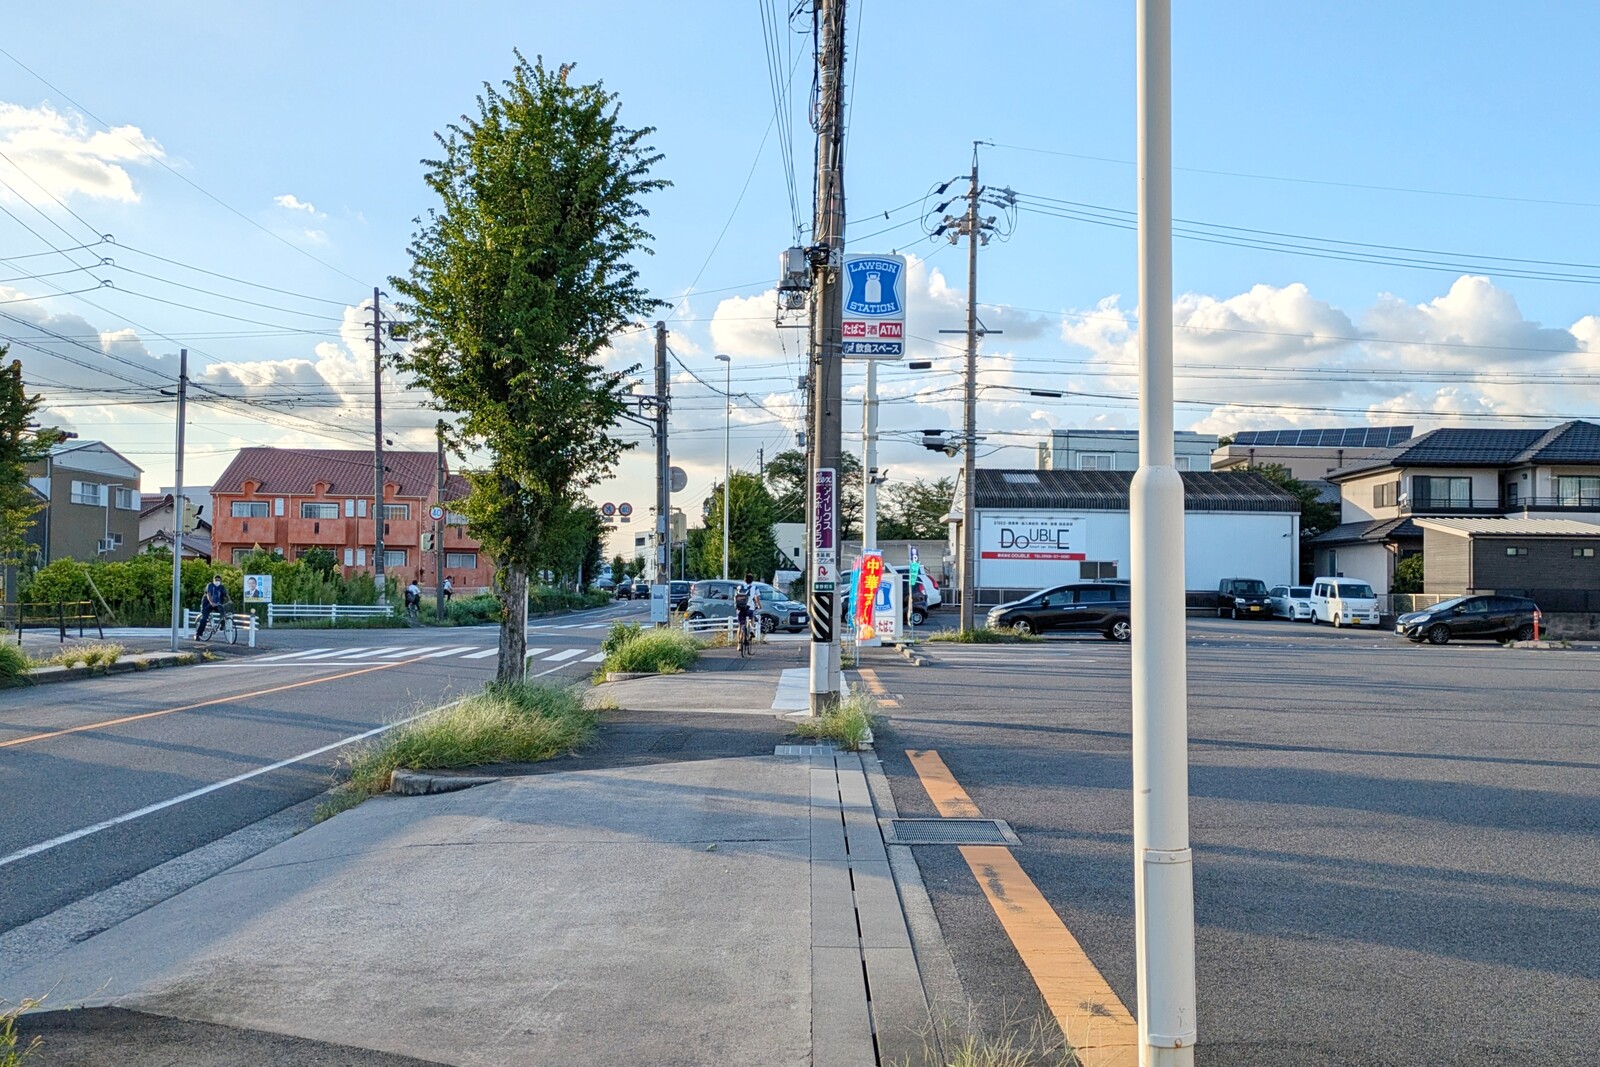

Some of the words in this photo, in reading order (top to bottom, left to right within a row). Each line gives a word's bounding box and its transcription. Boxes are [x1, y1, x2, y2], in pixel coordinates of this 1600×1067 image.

[850, 262, 897, 273] LAWSON
[850, 302, 895, 313] STATION
[843, 323, 865, 335] たばこ
[880, 324, 901, 335] ATM
[855, 343, 900, 353] 飲食スペース
[432, 508, 442, 517] 40
[823, 486, 832, 530] アイレクス
